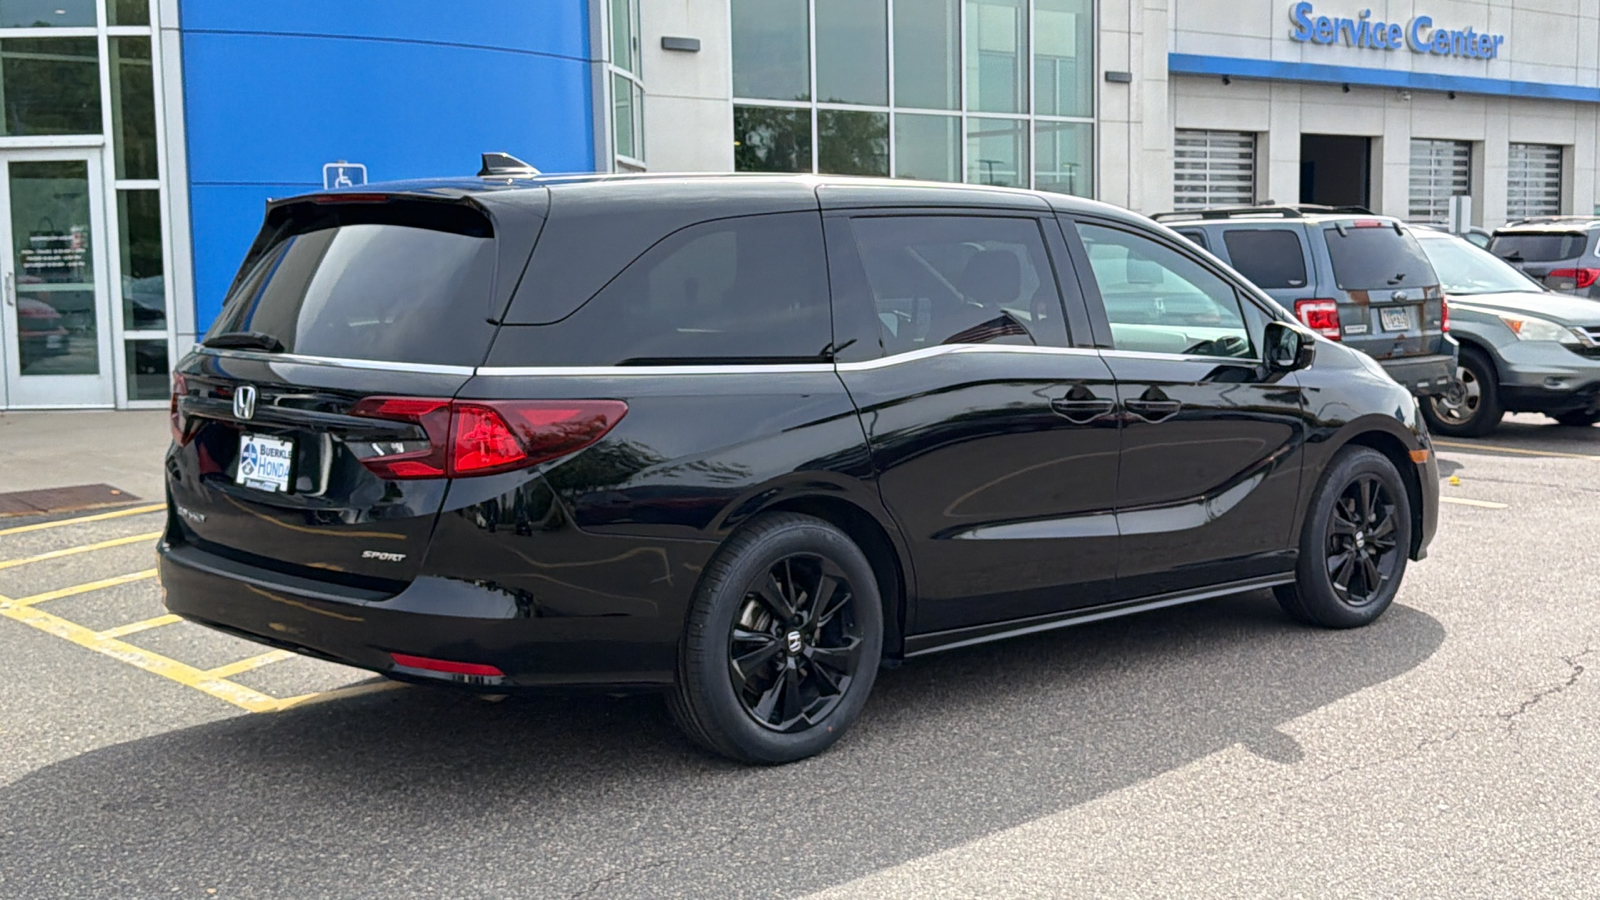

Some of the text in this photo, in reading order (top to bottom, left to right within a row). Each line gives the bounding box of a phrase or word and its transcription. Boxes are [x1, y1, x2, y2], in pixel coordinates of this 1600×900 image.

[1289, 2, 1504, 60] Service Center
[260, 443, 292, 460] BUERKLE
[257, 456, 291, 478] HONDA
[361, 550, 407, 562] SPORT
